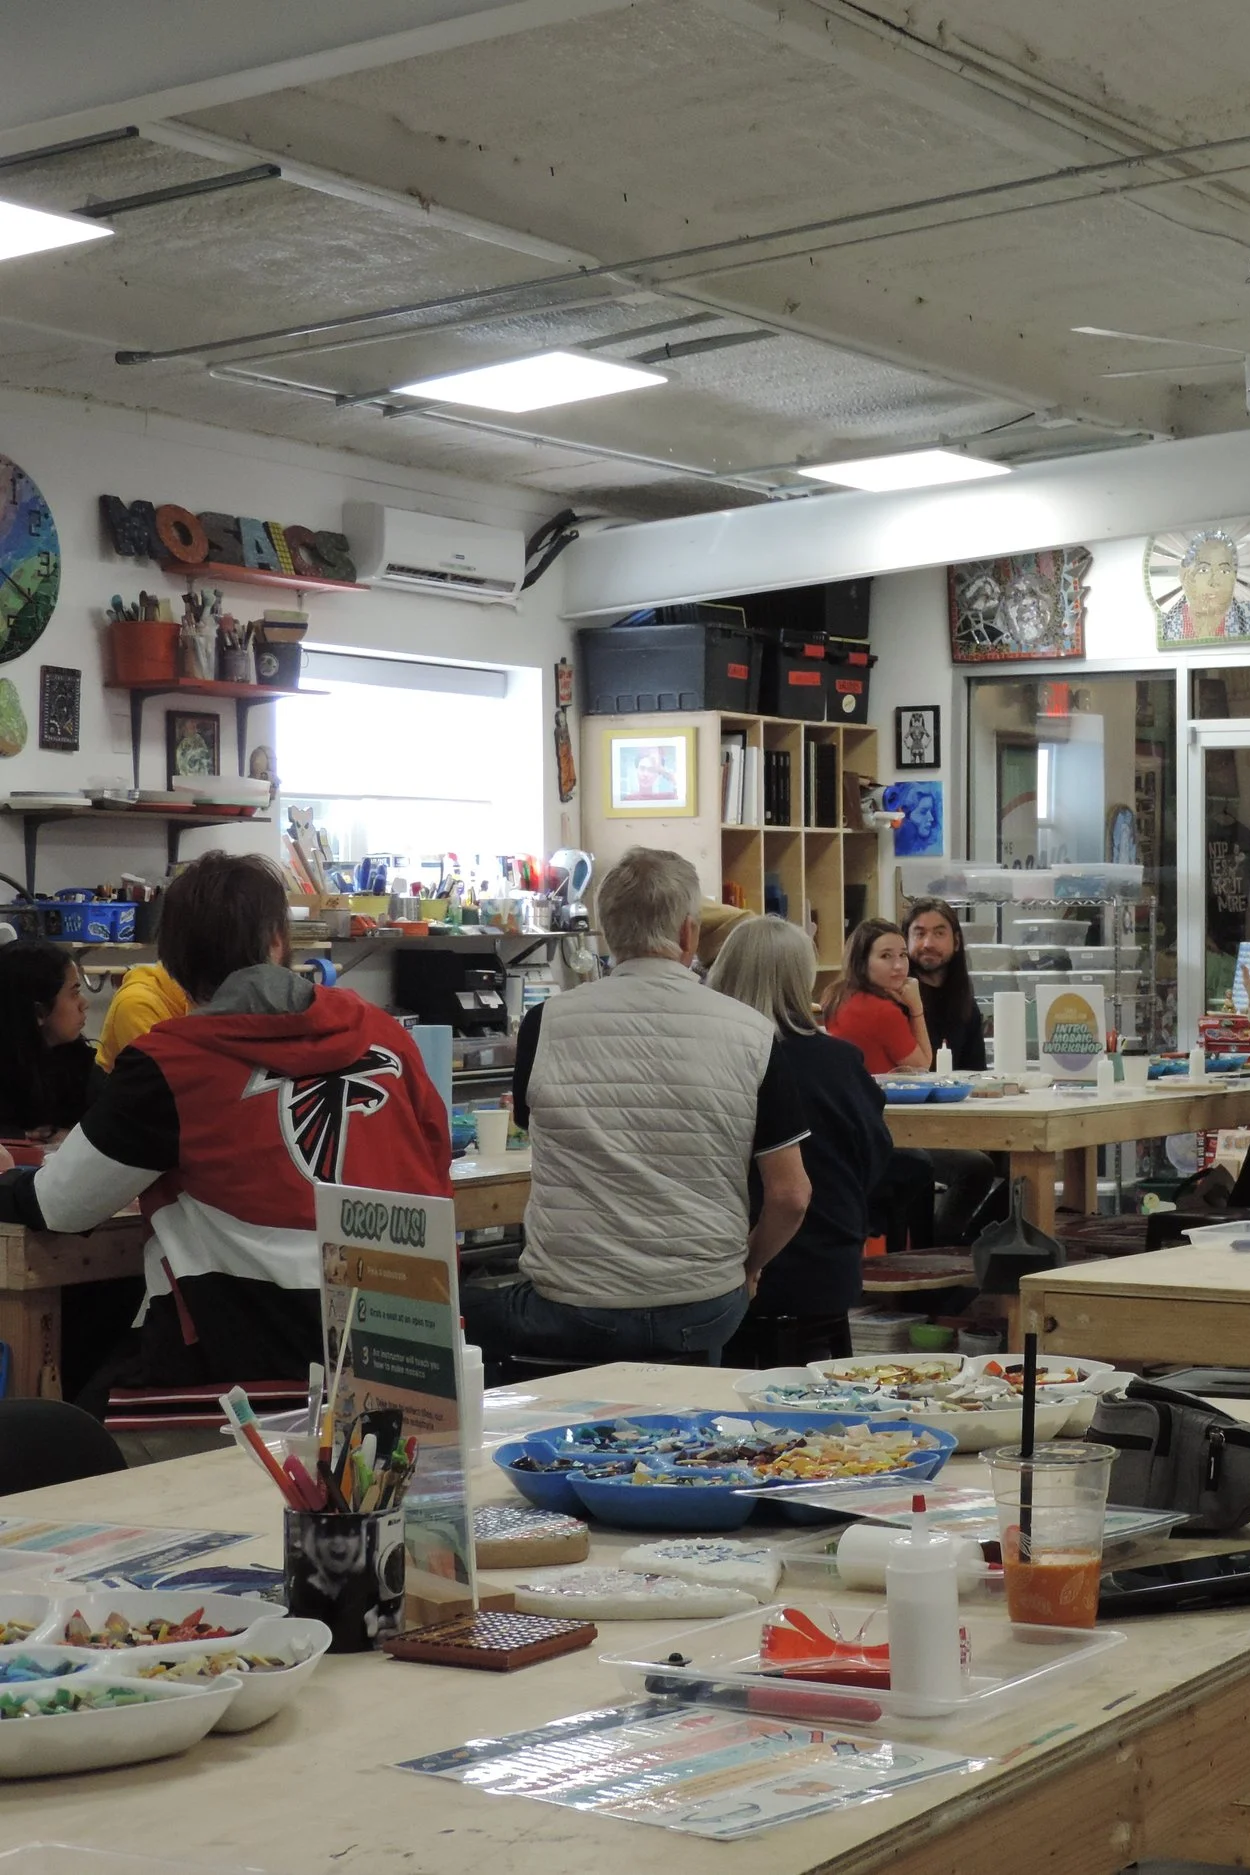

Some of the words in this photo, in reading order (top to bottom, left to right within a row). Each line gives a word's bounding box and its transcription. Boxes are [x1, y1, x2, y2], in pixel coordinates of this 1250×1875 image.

[99, 493, 358, 584] MOSAICS
[1208, 841, 1229, 859] NIP
[1051, 1032, 1094, 1044] MOSAIC
[1055, 1022, 1089, 1034] INTRO
[1043, 1041, 1104, 1055] WORKSHOP
[341, 1198, 389, 1243] DROP
[389, 1204, 427, 1249] INS!
[356, 1255, 365, 1283] 1
[357, 1297, 368, 1323] 2
[361, 1344, 370, 1366] 3
